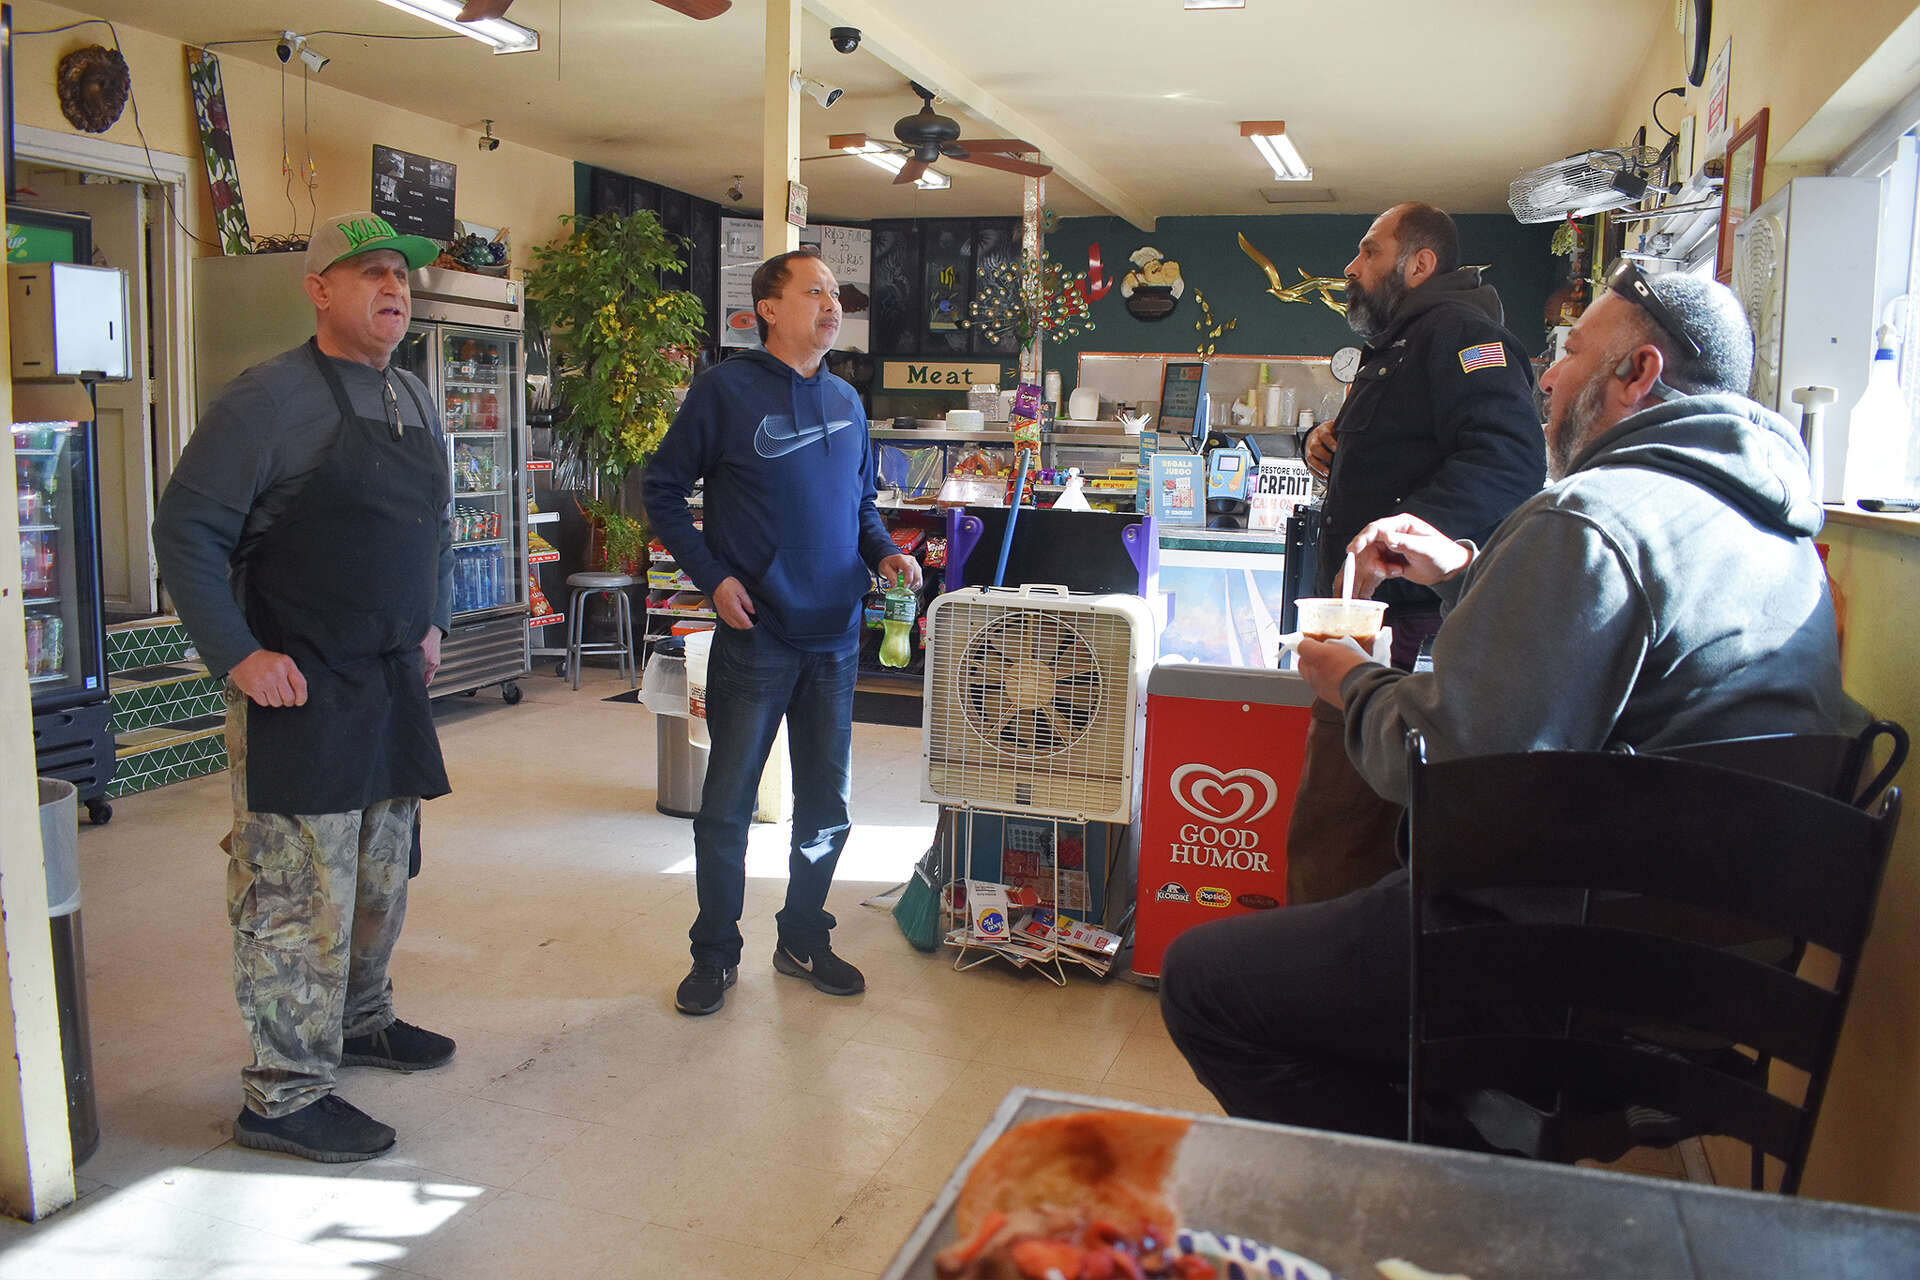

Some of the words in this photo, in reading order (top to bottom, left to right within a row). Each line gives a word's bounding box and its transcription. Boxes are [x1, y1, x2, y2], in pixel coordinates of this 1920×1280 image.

[907, 364, 974, 385] Meat
[1260, 465, 1291, 475] RESTORE
[1292, 468, 1310, 476] YOUR
[1180, 823, 1259, 849] GOOD
[1169, 843, 1271, 872] HUMOR
